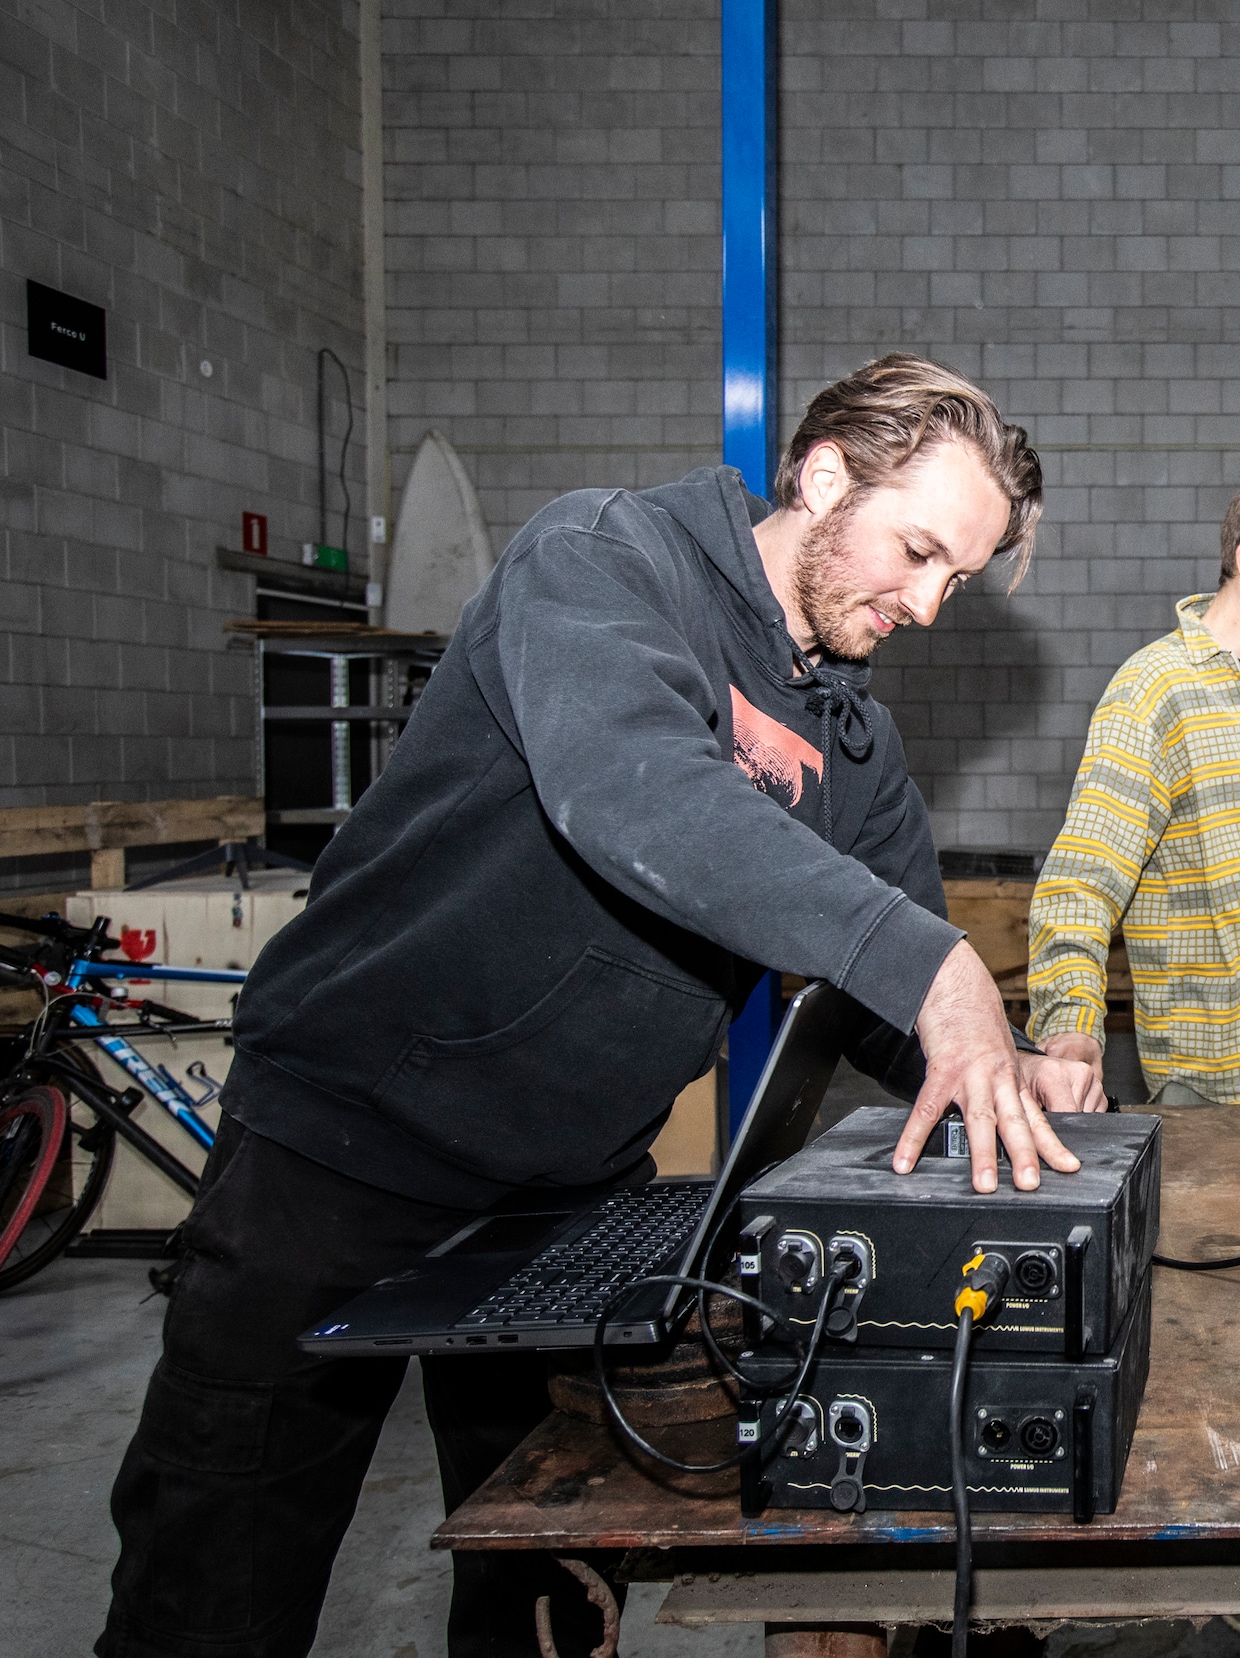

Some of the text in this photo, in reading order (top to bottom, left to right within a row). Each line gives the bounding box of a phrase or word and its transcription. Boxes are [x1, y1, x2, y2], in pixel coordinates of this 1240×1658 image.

[50, 321, 77, 338] Ferco
[97, 1036, 193, 1117] TREK
[741, 1261, 756, 1270] 105
[740, 1428, 755, 1437] 120
